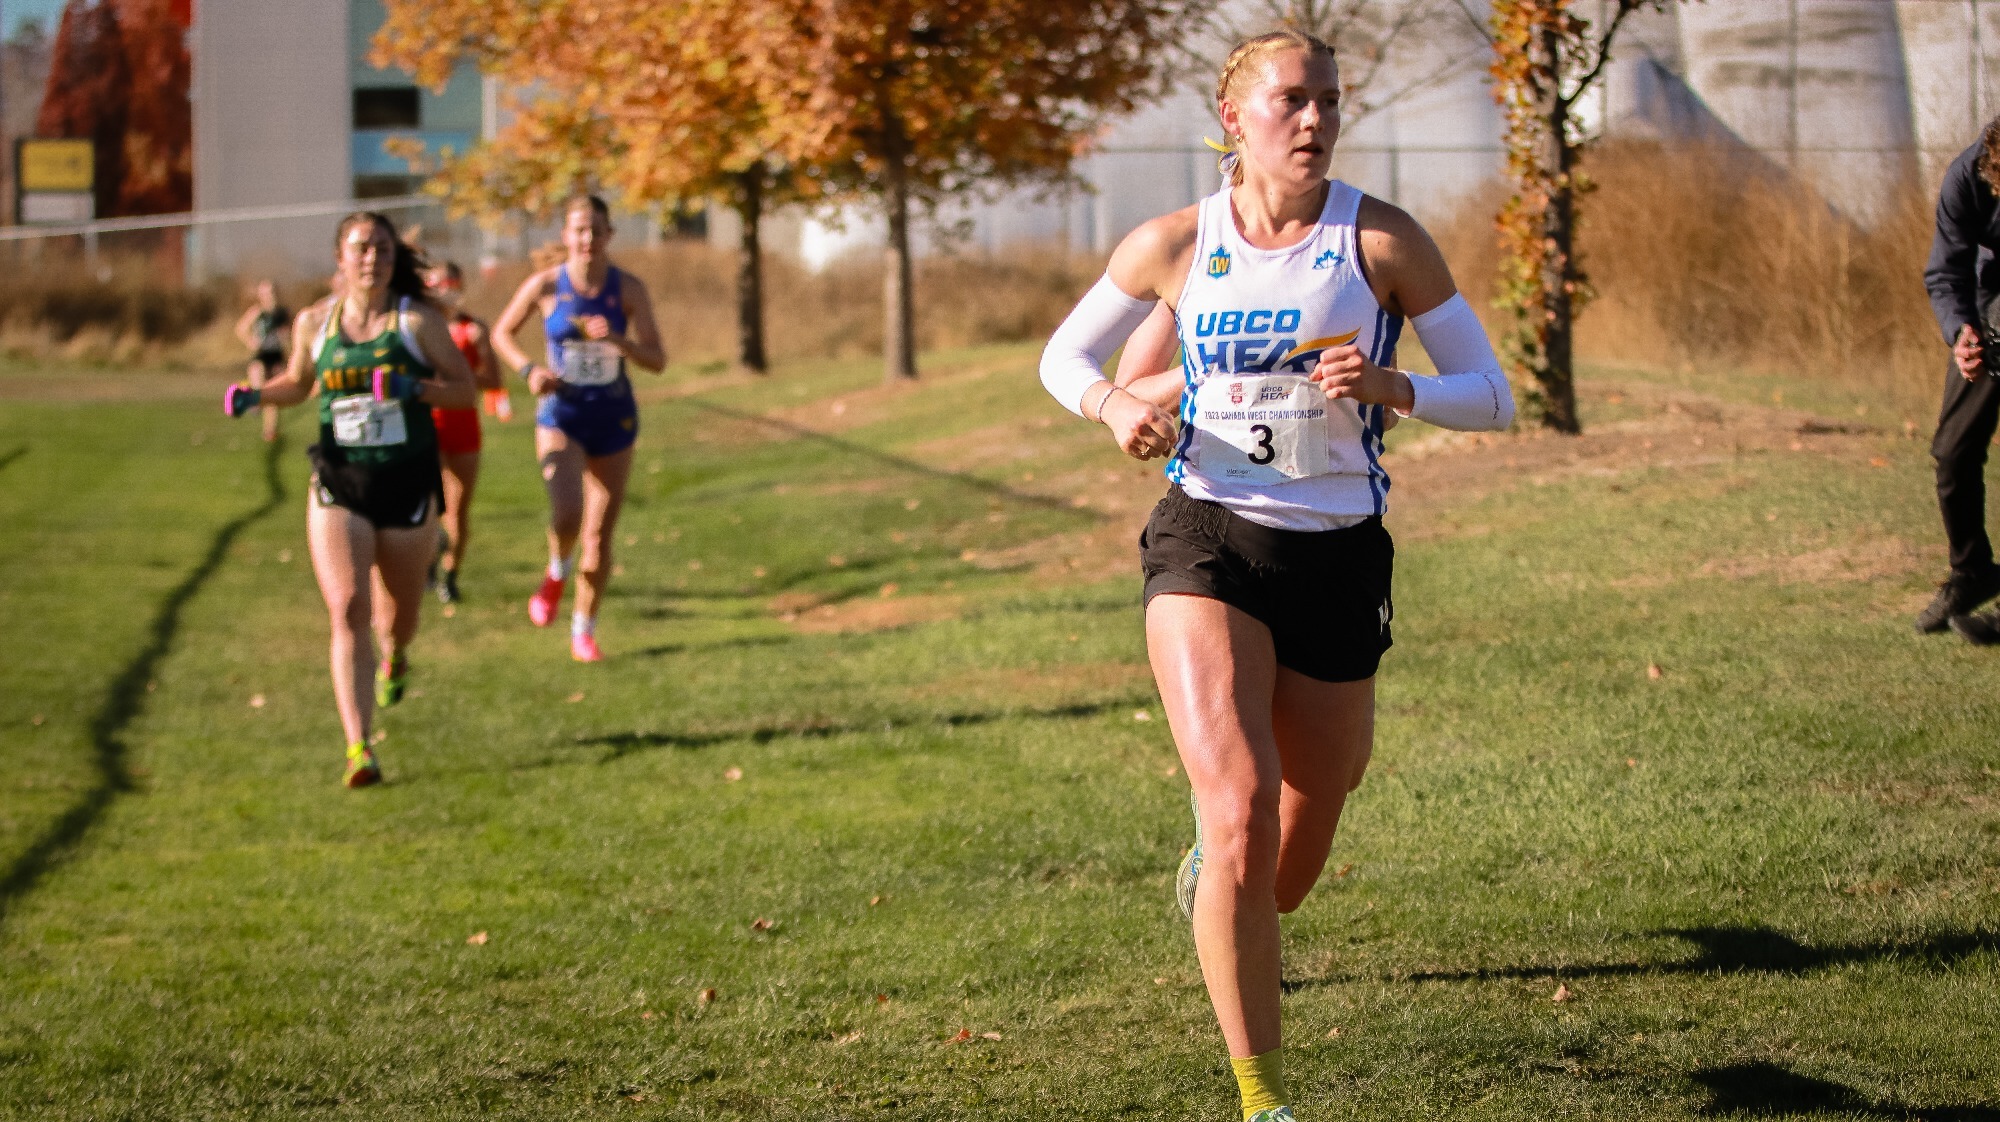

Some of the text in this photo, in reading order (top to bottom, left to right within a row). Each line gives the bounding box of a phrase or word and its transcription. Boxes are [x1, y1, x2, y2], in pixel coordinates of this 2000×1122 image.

[1196, 309, 1301, 338] UBCO
[1196, 332, 1350, 374] HEA
[1220, 410, 1246, 421] CANADA
[1247, 410, 1267, 420] WEST
[1268, 408, 1324, 420] CHAMPIONSHIP
[1247, 424, 1276, 466] 3
